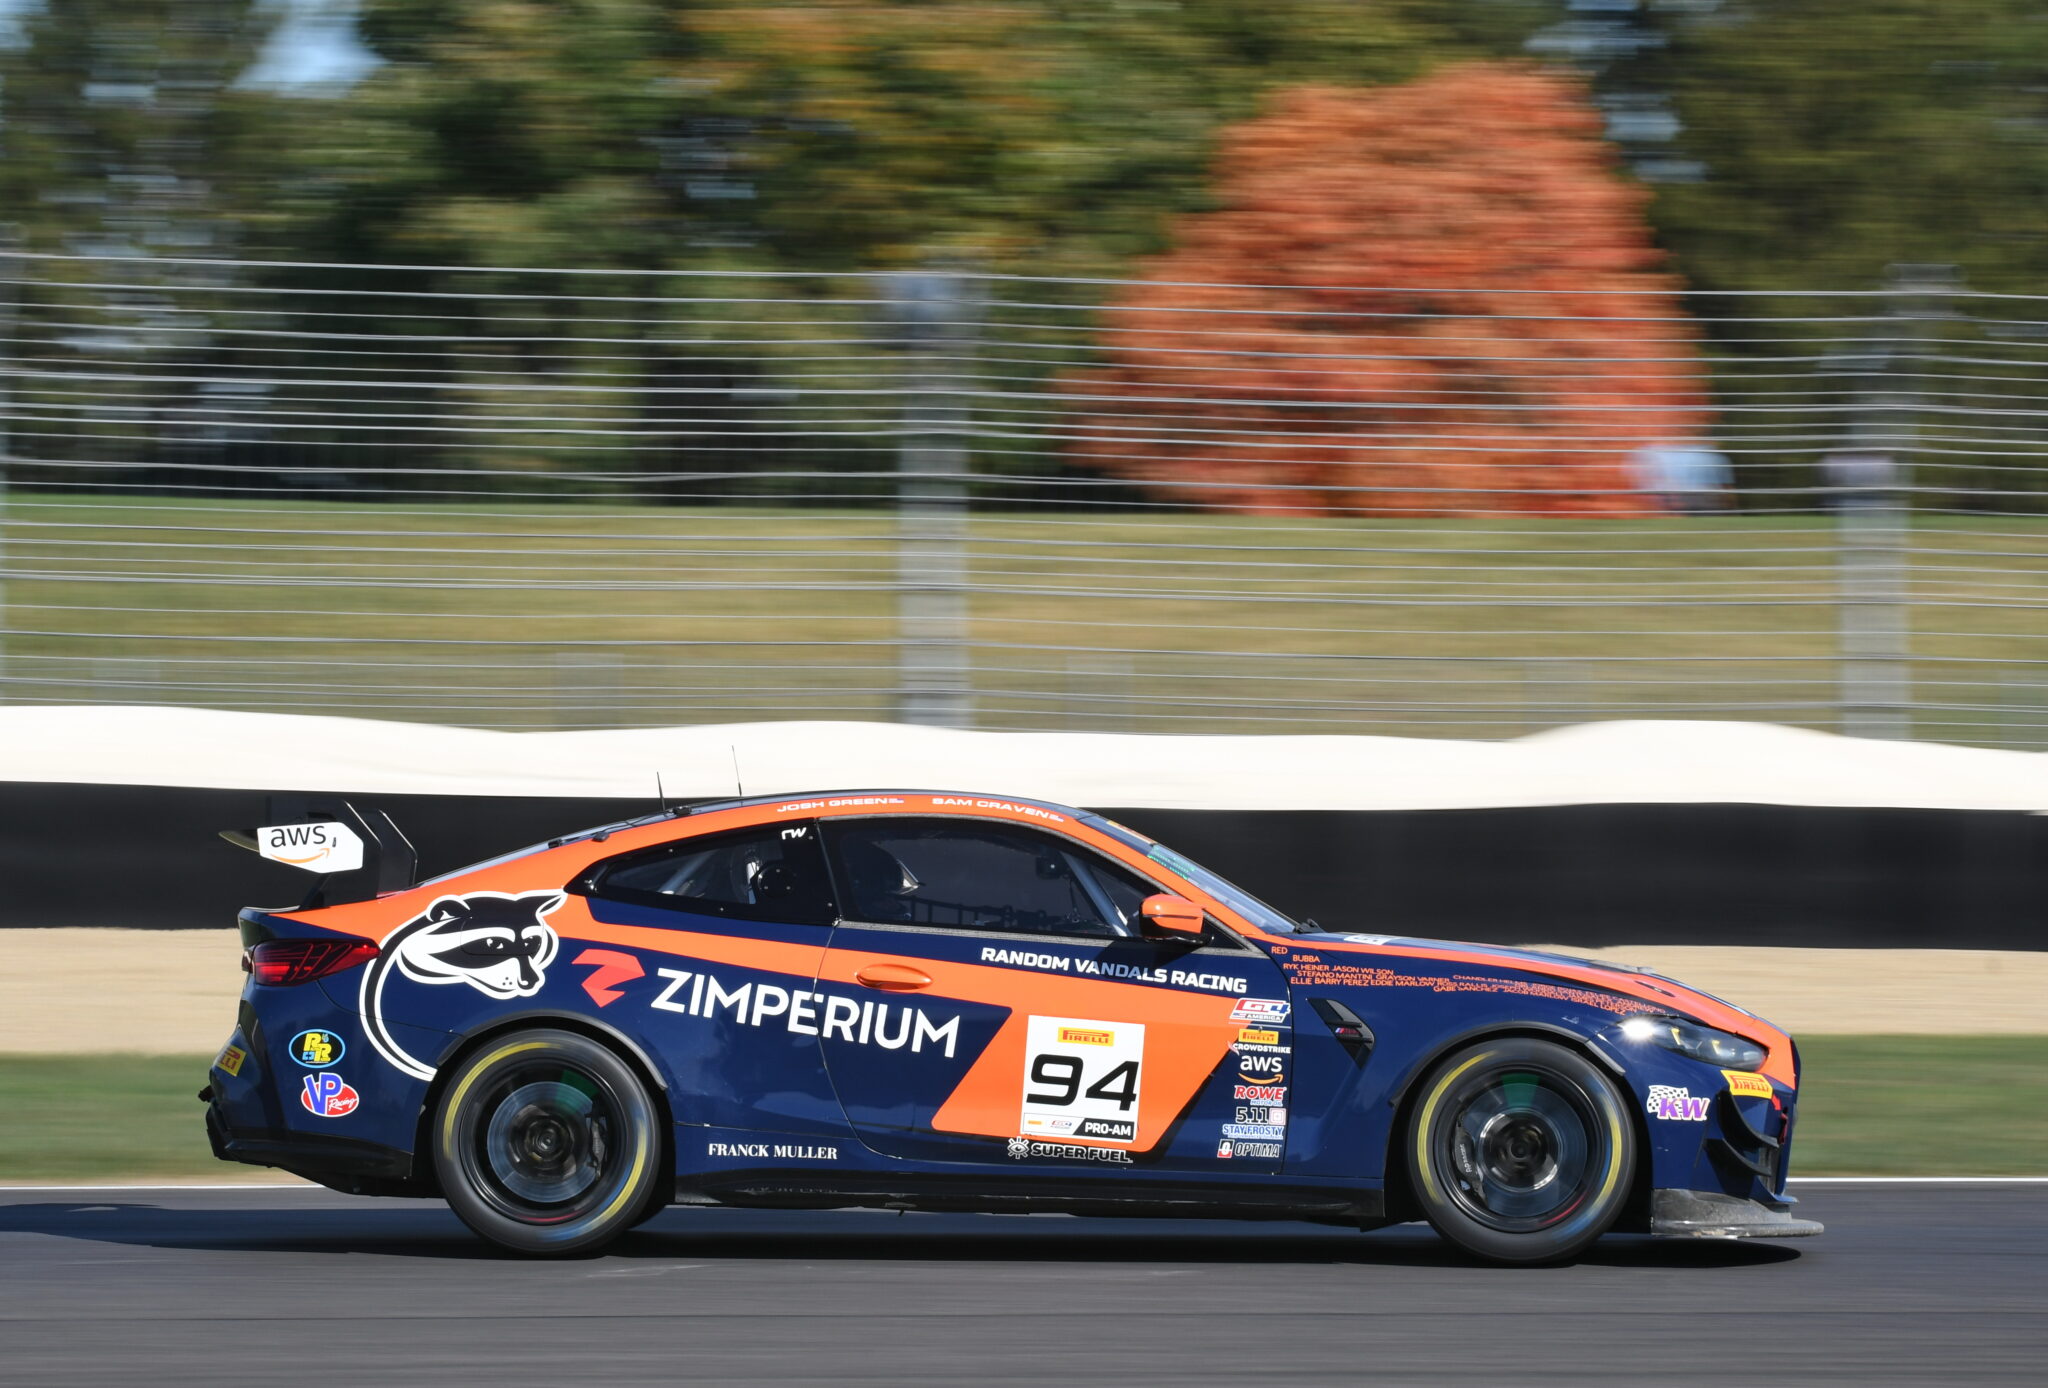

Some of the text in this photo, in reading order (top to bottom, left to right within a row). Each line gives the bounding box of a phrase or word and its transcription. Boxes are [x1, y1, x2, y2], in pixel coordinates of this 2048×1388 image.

[777, 798, 888, 812] JOSH GREEN
[932, 798, 1050, 819] SAM CRAVEN
[270, 825, 327, 848] aws
[1292, 955, 1320, 963] BUBBA
[981, 946, 1247, 993] RANDOM VANDALS RACING
[1297, 970, 1335, 979] STEFANO
[1301, 964, 1330, 972] HEINER
[1332, 965, 1359, 974] JASON
[1361, 967, 1394, 976] WILSON
[1290, 977, 1312, 985] ELLIE
[1314, 977, 1341, 985] BARRY
[1370, 979, 1395, 987] EDDIE
[651, 967, 960, 1058] ZIMPERIUM
[1246, 1013, 1283, 1021] AMERICA
[1063, 1030, 1110, 1044] PIRELLI
[1232, 1043, 1291, 1054] CROWDSTRIKE
[1241, 1055, 1282, 1073] aws
[1026, 1054, 1139, 1111] 94
[1729, 1074, 1769, 1092] PIRELLI
[303, 1073, 343, 1116] VP
[1235, 1086, 1284, 1100] ROWE
[328, 1097, 358, 1111] Racing
[1657, 1097, 1710, 1120] KW
[1236, 1107, 1268, 1124] 5.11
[1084, 1121, 1131, 1136] PRO-AM
[1223, 1125, 1284, 1136] STAY FROSTY
[708, 1143, 837, 1160] FRANCK MULLER
[1030, 1142, 1086, 1160] SUPER
[1235, 1142, 1280, 1157] OPTIMA
